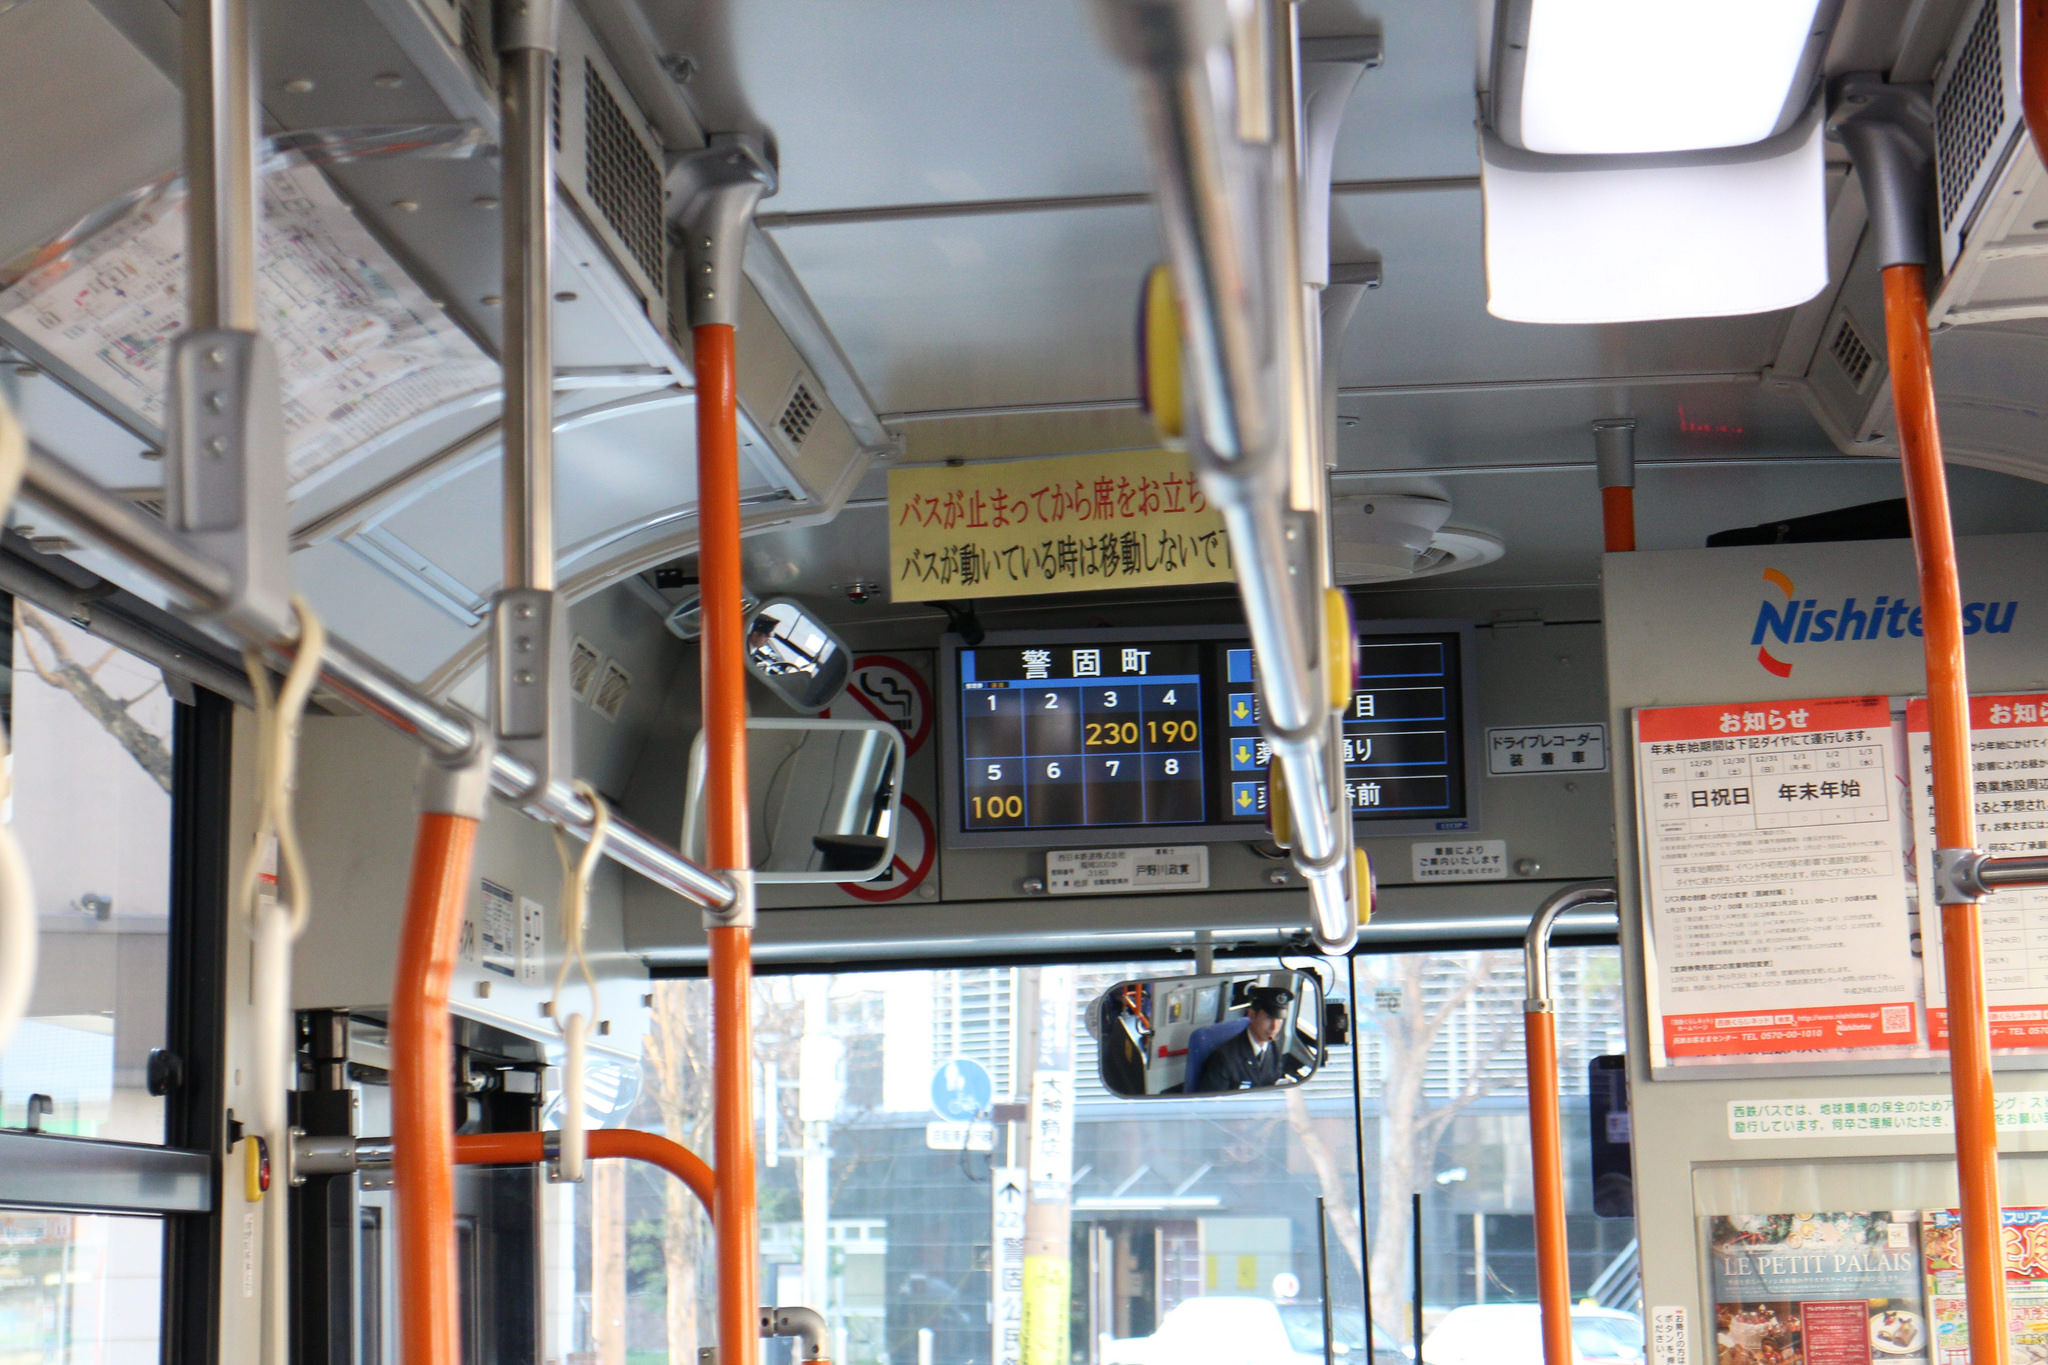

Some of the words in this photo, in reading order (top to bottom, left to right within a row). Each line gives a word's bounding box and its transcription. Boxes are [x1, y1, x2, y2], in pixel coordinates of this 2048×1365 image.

[1750, 595, 2018, 645] Nishitesu
[1021, 648, 1151, 680] 警固町
[987, 695, 997, 711] 1
[1044, 693, 1059, 709] 2
[1103, 691, 1118, 707] 3
[1162, 689, 1177, 705] 4
[1085, 722, 1140, 746] 230
[1147, 720, 1198, 743] 190
[1719, 709, 1809, 733] お知らせ
[1493, 732, 1601, 750] ドライブレコーダー
[1651, 729, 1872, 755] 年末年始期間は下記ダイヤにて運行します。
[987, 764, 1002, 781] 5
[1046, 762, 1061, 779] 6
[1105, 761, 1120, 777] 7
[1164, 758, 1179, 775] 8
[1691, 787, 1750, 808] 日祝日
[1778, 779, 1861, 802] 年末年始
[972, 795, 1023, 819] 100
[1742, 1033, 1759, 1041] TEL
[1724, 1257, 1752, 1276] LE
[1758, 1255, 1826, 1276] PETIT
[1833, 1252, 1912, 1273] PALAIS
